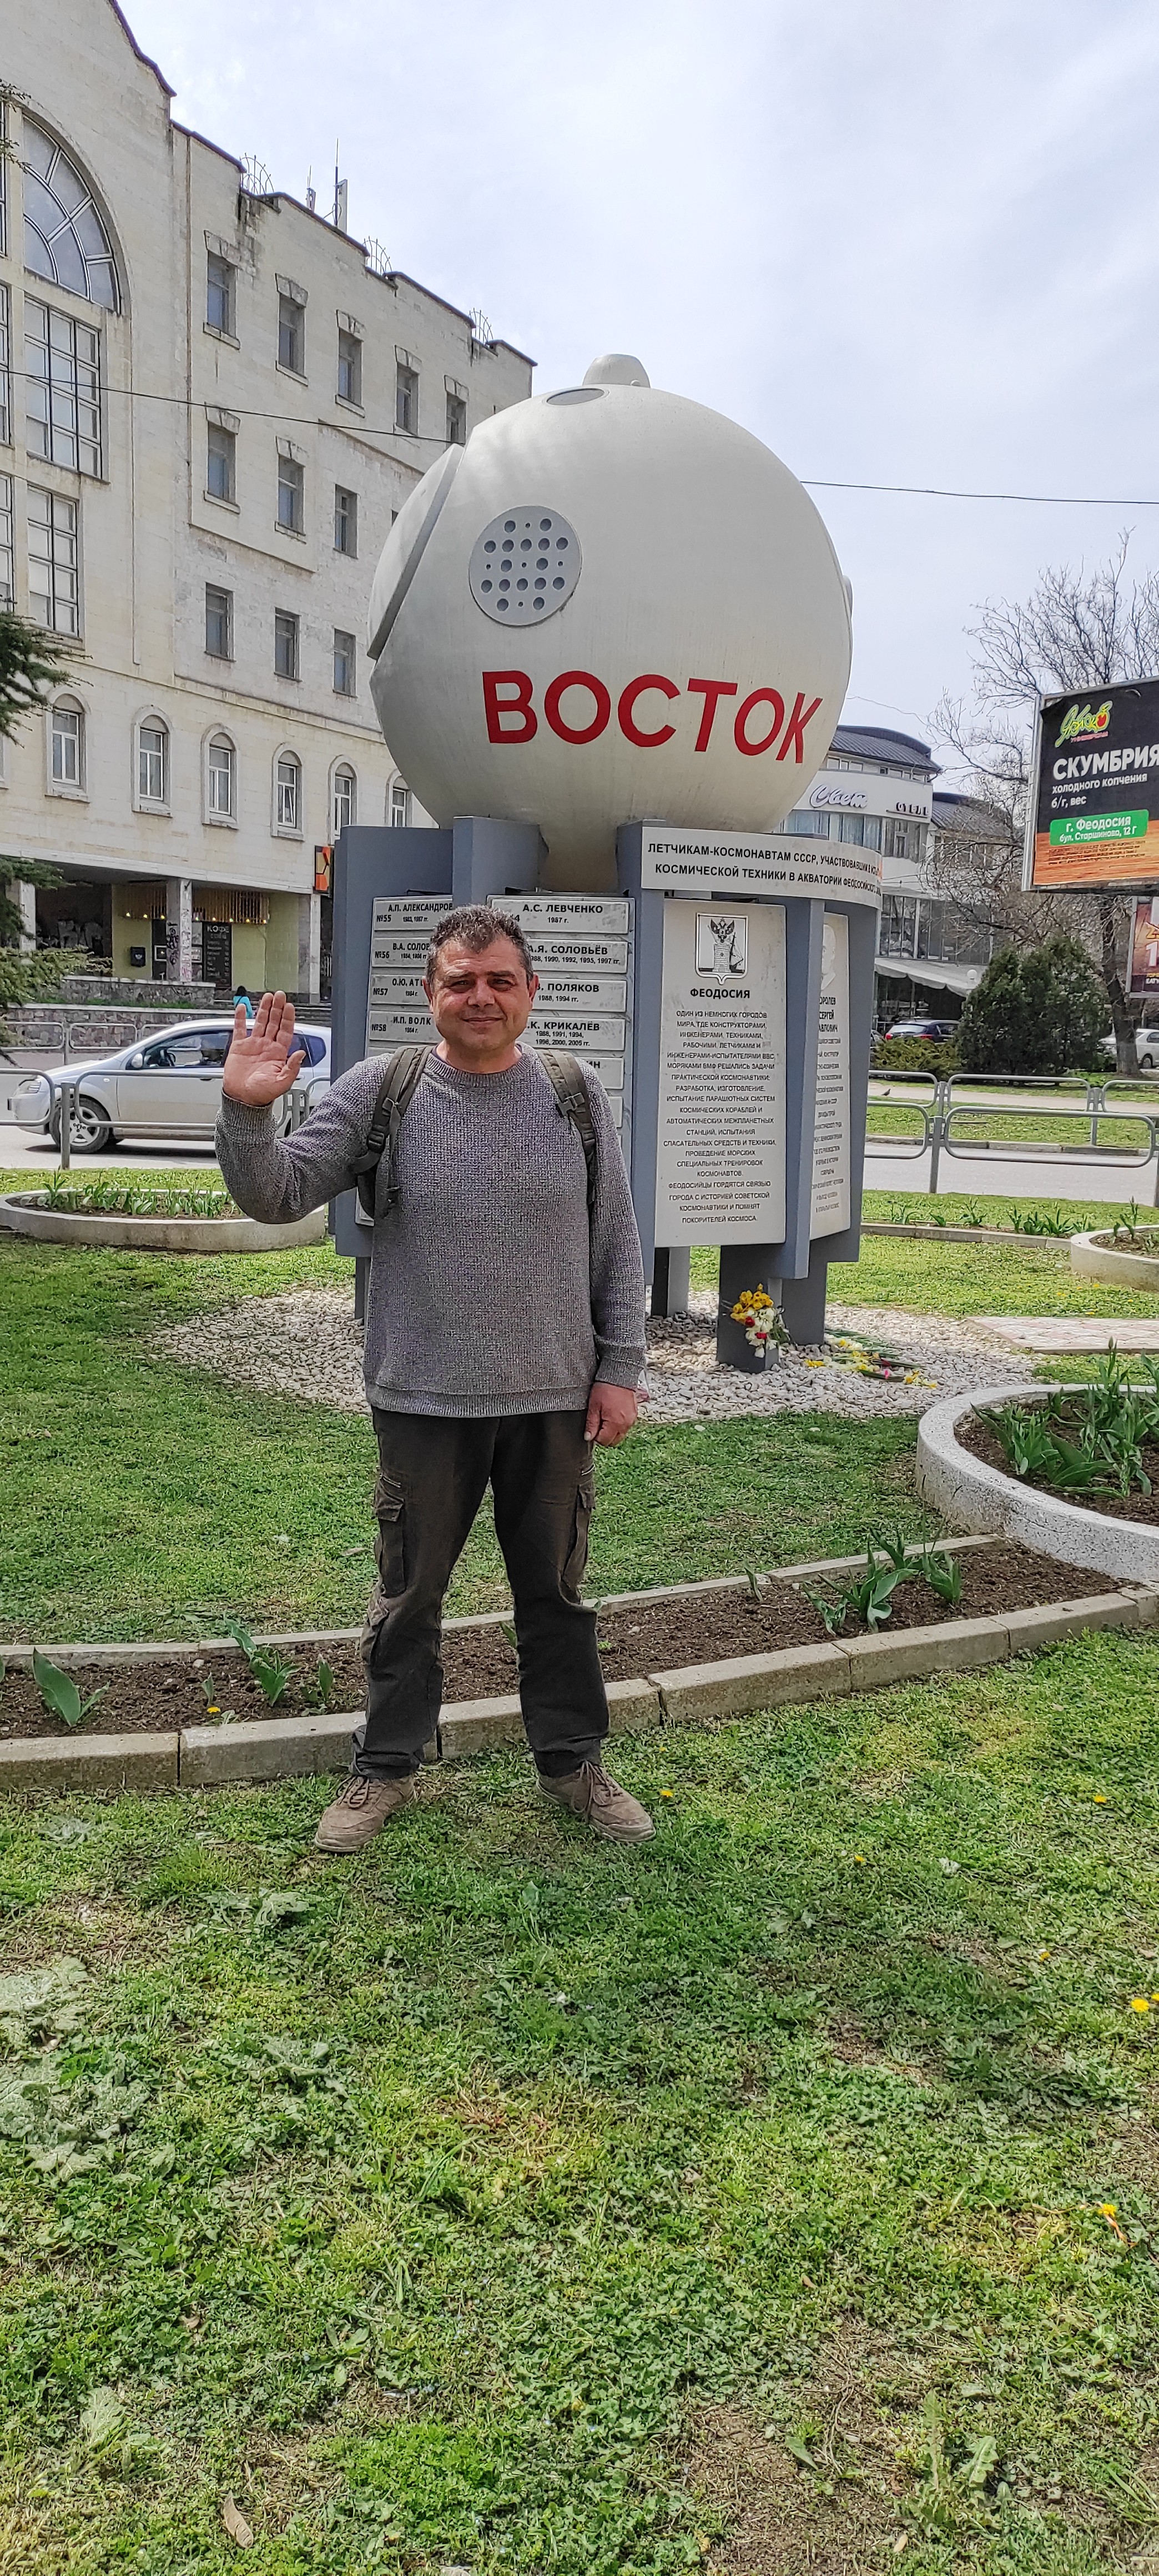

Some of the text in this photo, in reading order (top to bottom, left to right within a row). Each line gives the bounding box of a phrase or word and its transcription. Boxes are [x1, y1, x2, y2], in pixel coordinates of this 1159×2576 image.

[482, 670, 823, 763] ВОСТОК
[1053, 744, 1159, 780] СКУМБРИЯ
[1052, 773, 1147, 794] холодного копчения
[809, 783, 868, 808] Свет
[1051, 796, 1087, 809] б/г, вес
[1066, 816, 1131, 832] г. Феодосия
[1060, 834, 1074, 844] бул.
[1123, 827, 1131, 835] 12
[648, 843, 791, 861] ЛЕТЧИКАМ-КОСМОНАВТАМ
[794, 853, 818, 866] СССР,
[656, 863, 739, 877] КОСМИЧЕСКОЙ
[742, 868, 786, 881] ТЕХНИКИ
[789, 872, 795, 881] В
[798, 873, 842, 886] АКВАТОРИИ
[388, 903, 401, 912] А.П.
[546, 904, 603, 913] ЛЕВЧЕНКО
[551, 945, 608, 954] СОЛОВЬЁВ
[392, 978, 407, 987] О.Ю.
[548, 983, 599, 992] ПОЛЯКОВ
[690, 988, 750, 999] ФЕОДОСИЯ
[409, 1017, 431, 1025] ВОЛК
[544, 1021, 599, 1031] КРИКАЛЁВ
